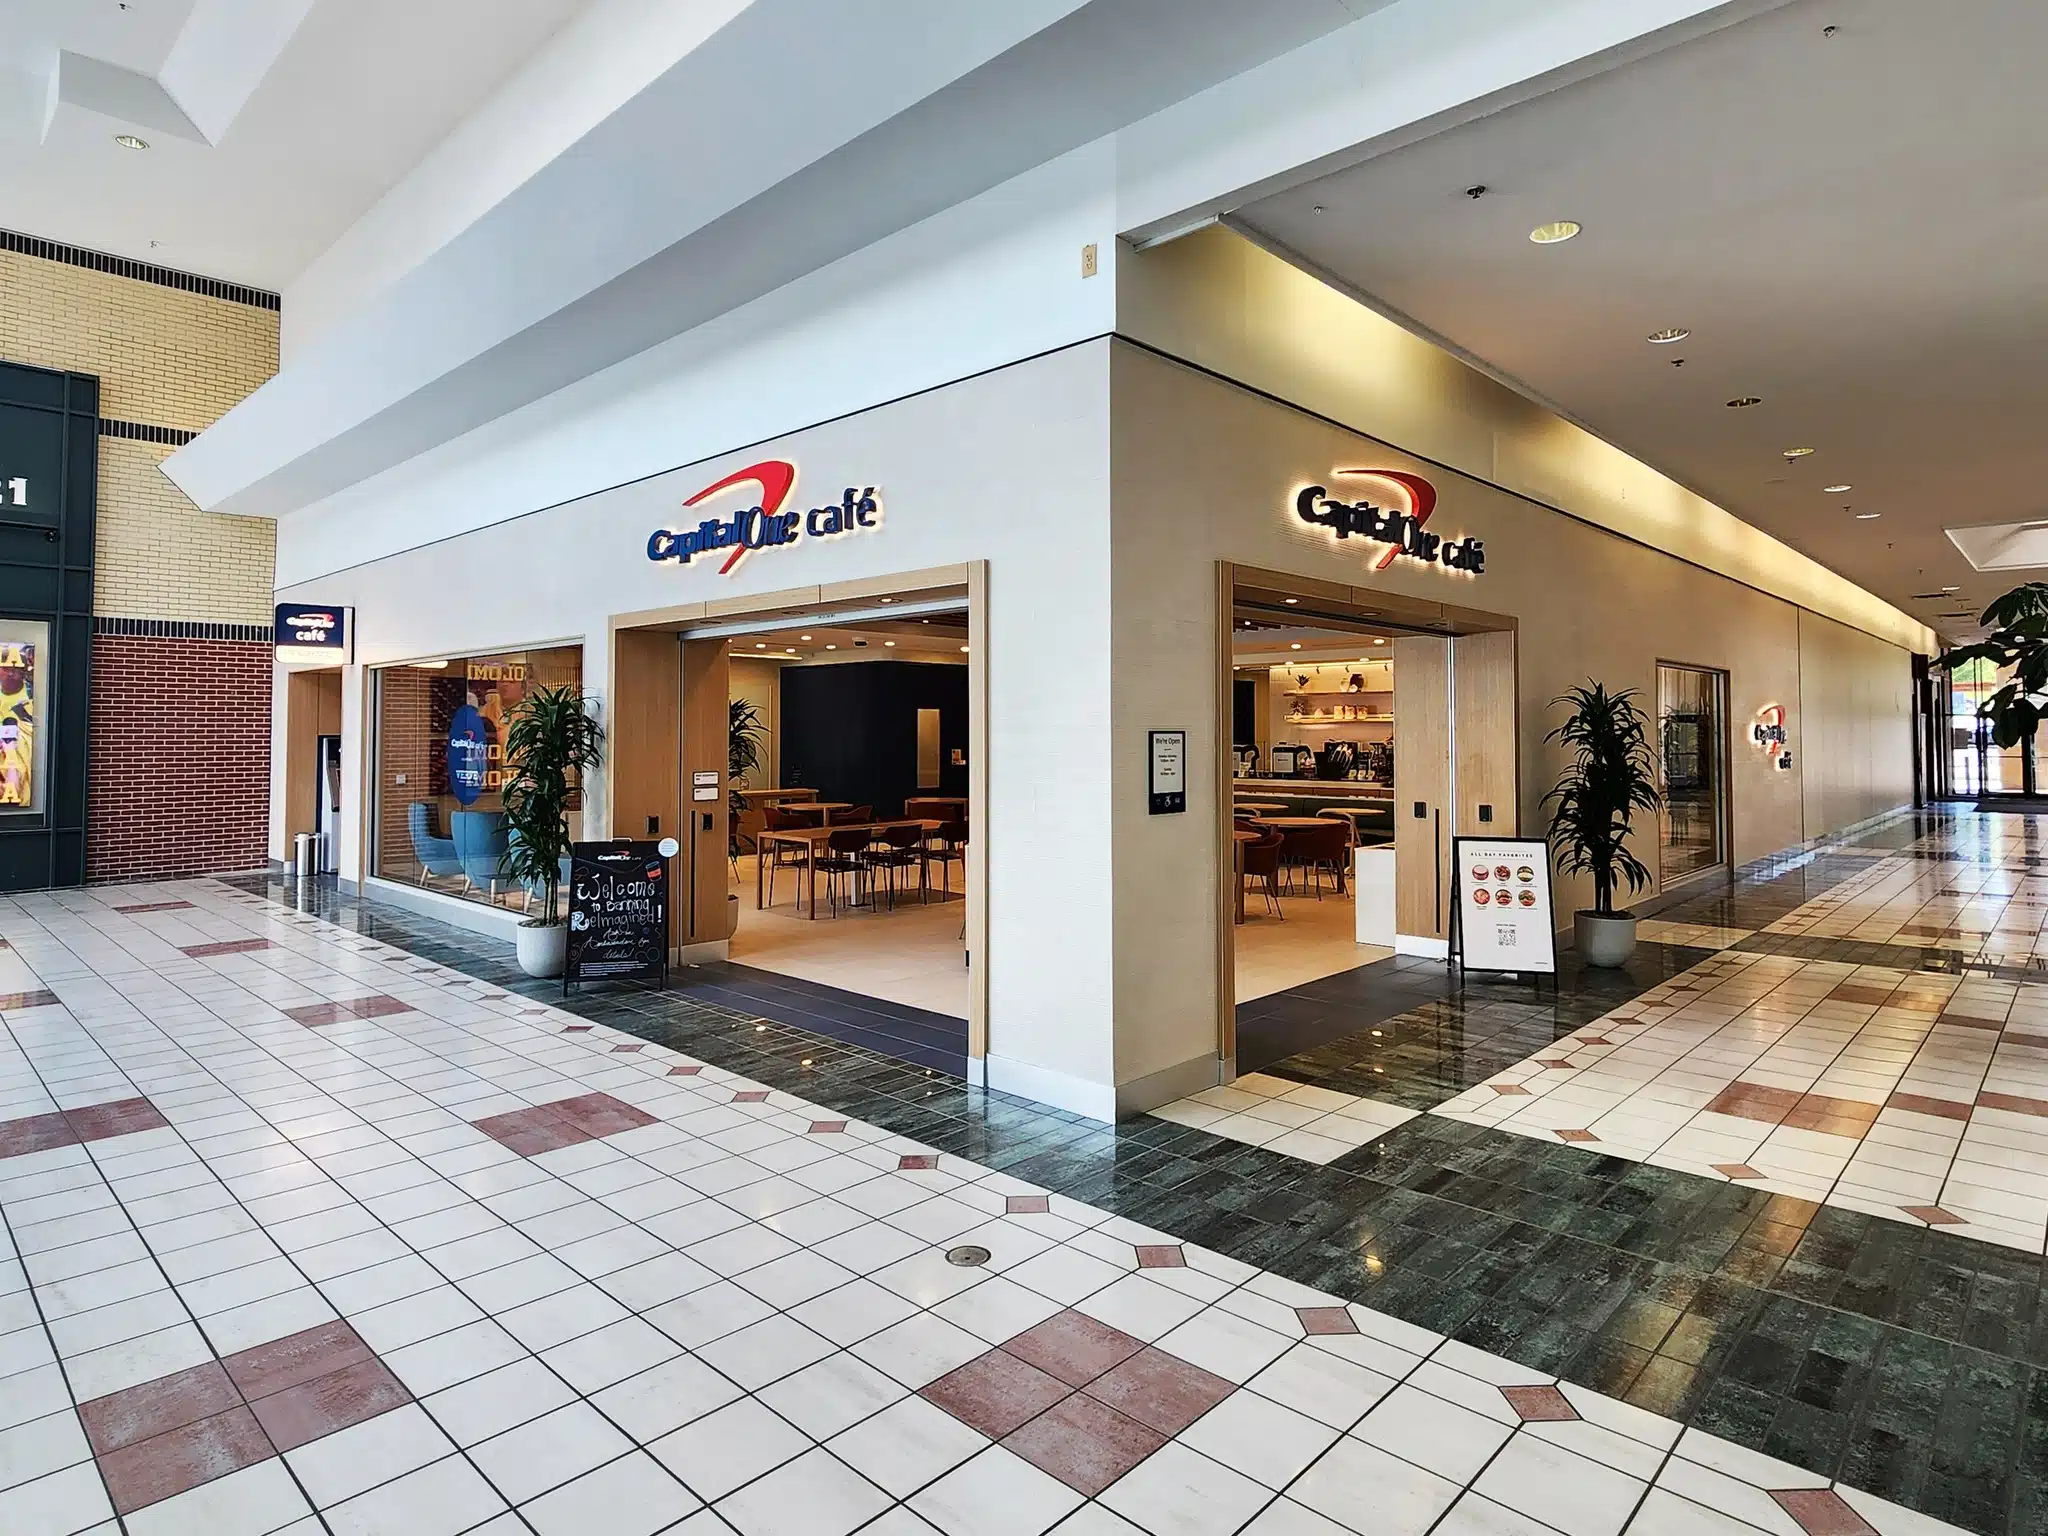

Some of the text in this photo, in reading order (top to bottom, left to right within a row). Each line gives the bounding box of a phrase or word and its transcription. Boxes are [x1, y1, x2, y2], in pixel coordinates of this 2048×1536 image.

[0, 477, 28, 505] 1
[806, 486, 878, 537] café
[1442, 536, 1486, 574] café
[295, 629, 326, 642] café
[1168, 737, 1180, 745] Open
[576, 873, 655, 900] Welcome
[591, 902, 601, 913] to
